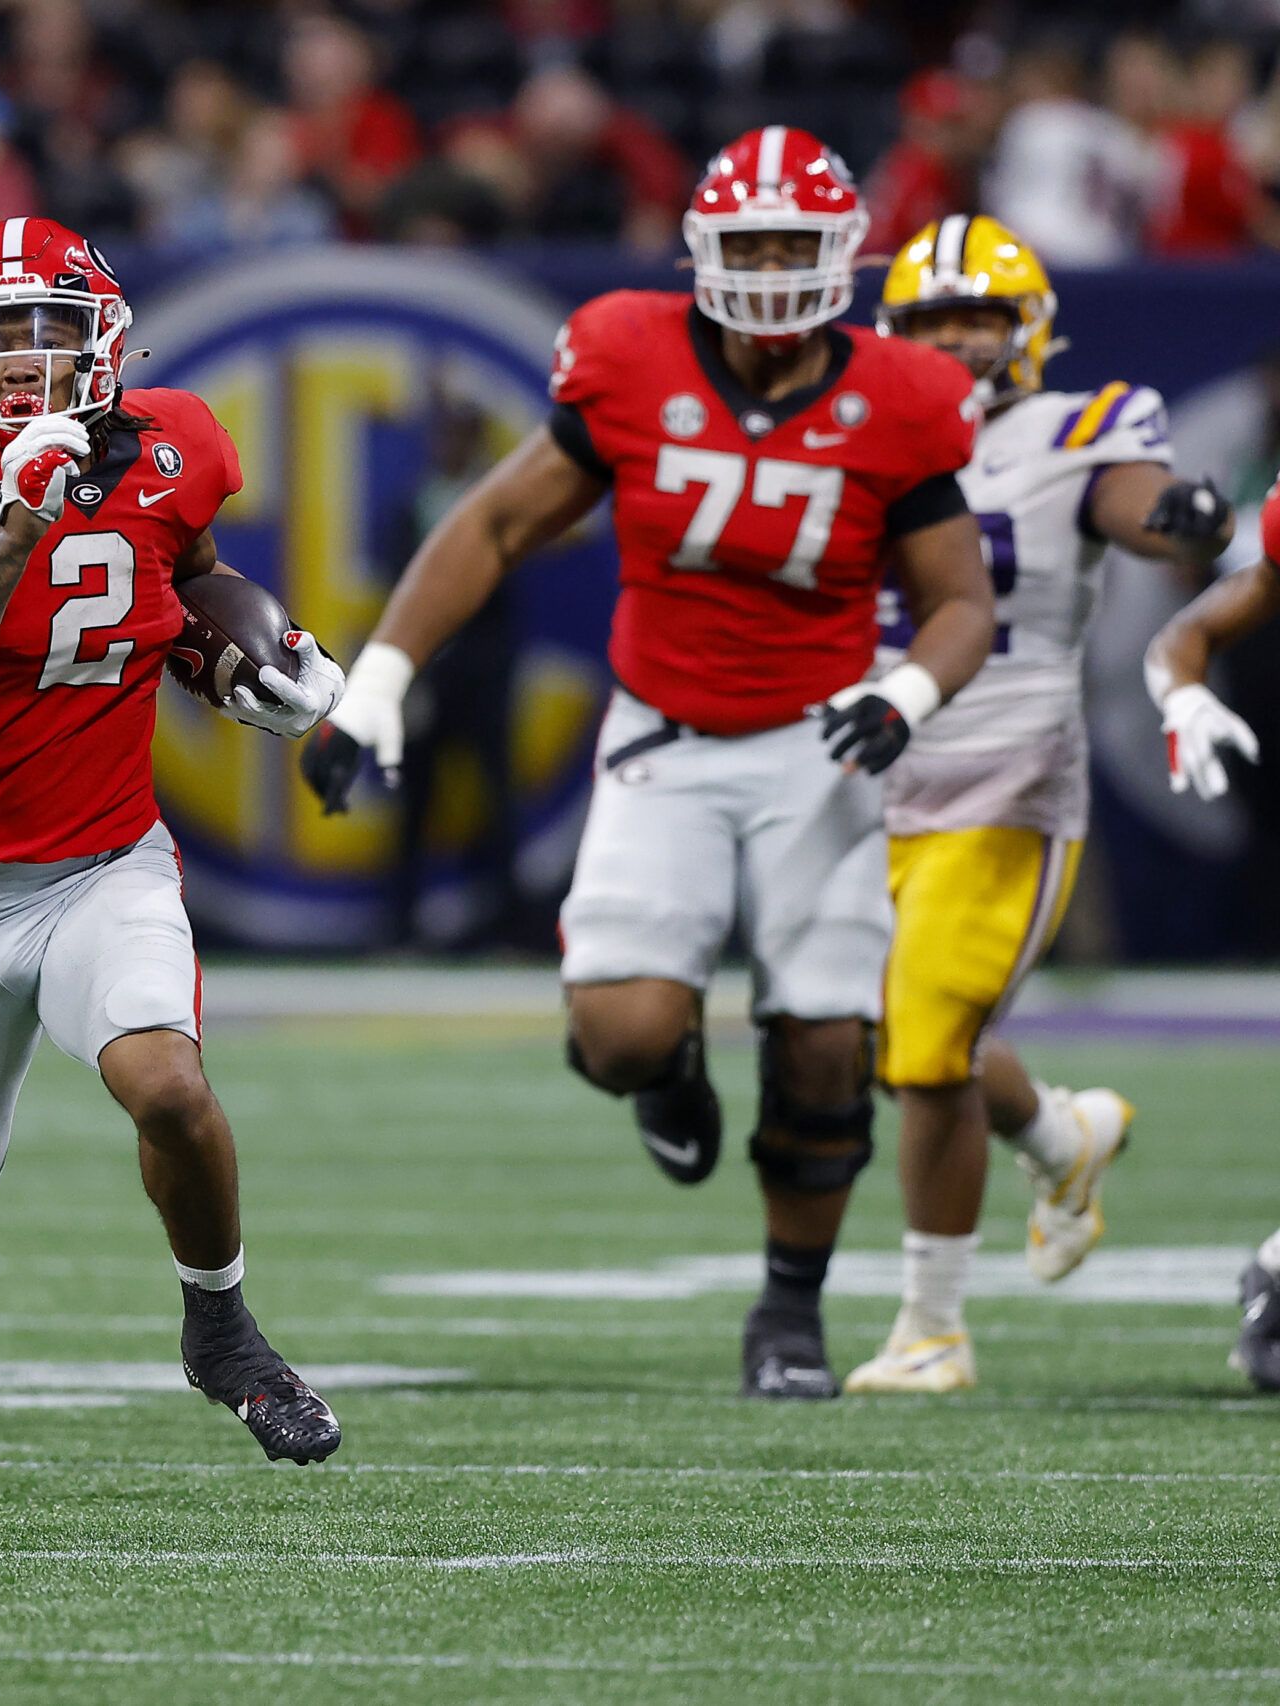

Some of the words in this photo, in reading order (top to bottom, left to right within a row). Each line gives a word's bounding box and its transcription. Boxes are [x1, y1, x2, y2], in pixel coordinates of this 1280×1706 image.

[75, 485, 102, 503] G
[653, 441, 846, 591] 77
[36, 529, 136, 693] 2
